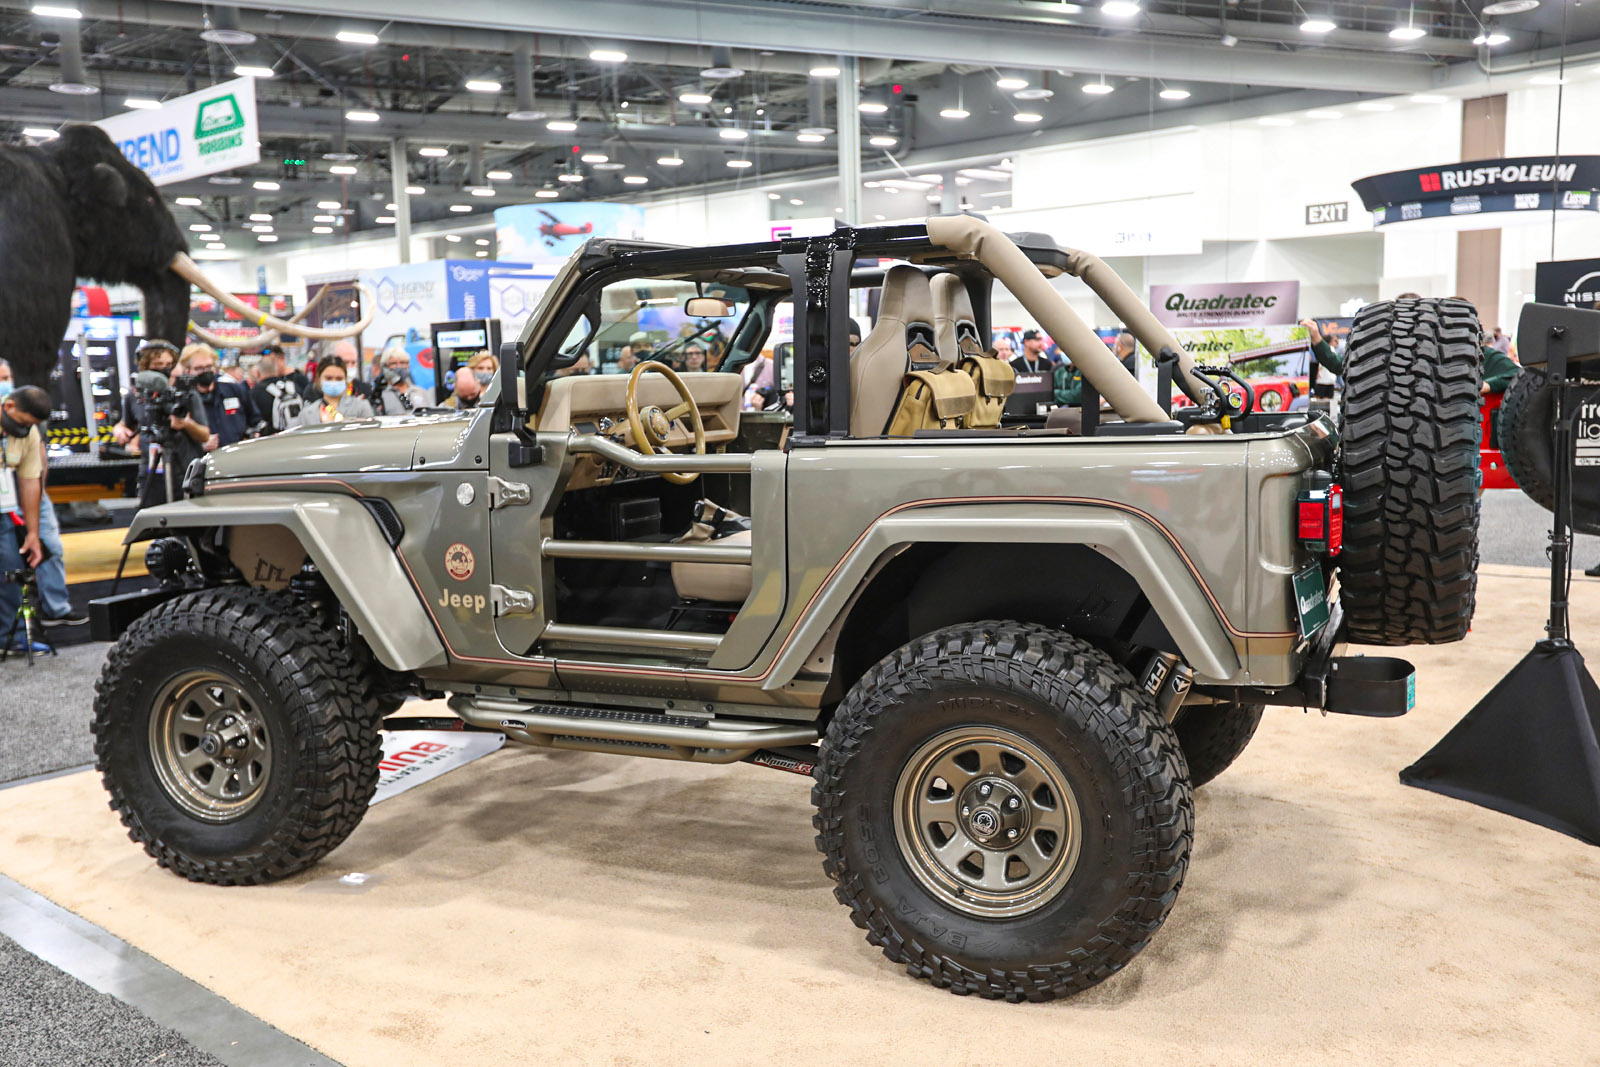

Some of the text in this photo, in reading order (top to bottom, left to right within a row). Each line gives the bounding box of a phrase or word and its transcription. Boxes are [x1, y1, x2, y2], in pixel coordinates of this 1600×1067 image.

[1441, 163, 1577, 190] RUST-OLEUM
[1309, 204, 1346, 223] EXIT
[1165, 292, 1278, 312] Quadratec
[439, 588, 486, 614] Jeep
